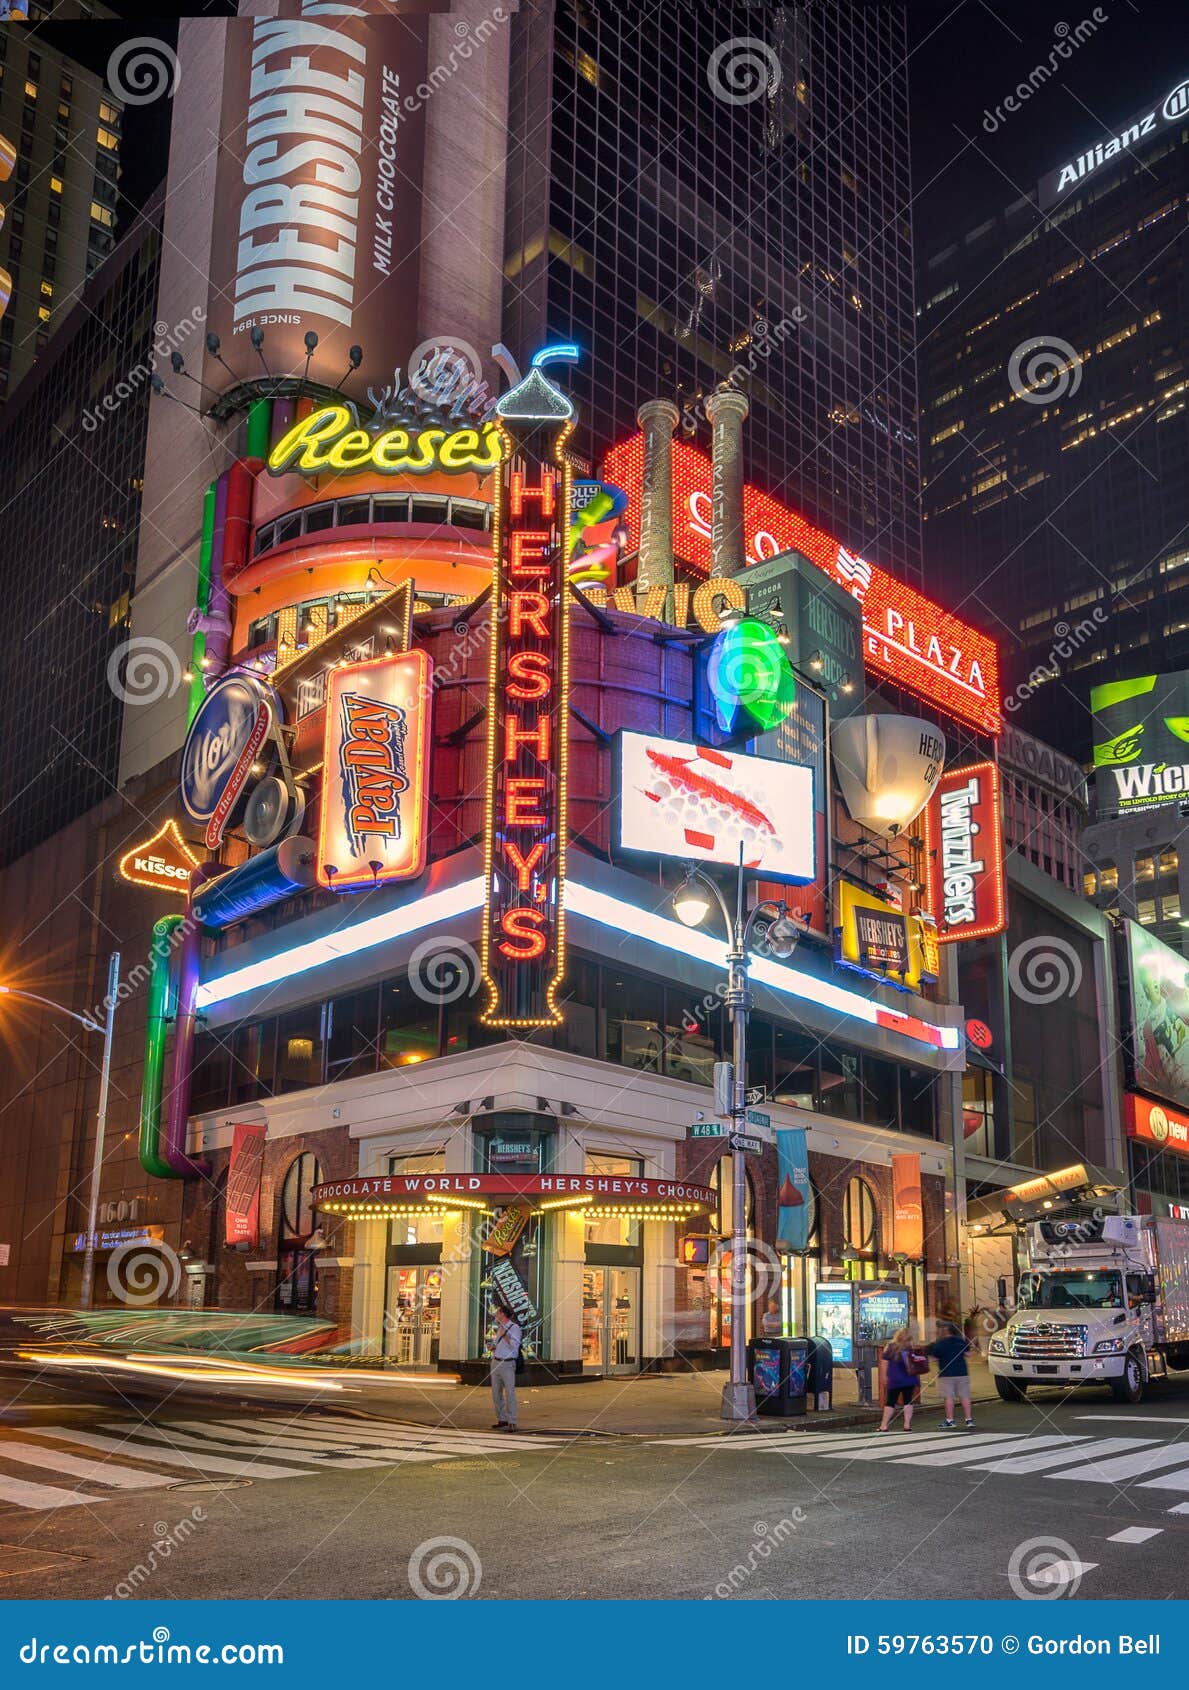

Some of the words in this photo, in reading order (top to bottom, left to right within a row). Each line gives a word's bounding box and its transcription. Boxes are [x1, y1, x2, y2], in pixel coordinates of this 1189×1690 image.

[377, 64, 400, 213] CHOCOLATE
[1057, 112, 1157, 193] Allianz
[372, 208, 394, 276] MILK
[233, 317, 258, 336] 1894
[260, 314, 301, 326] SINCE
[268, 404, 505, 472] Reese's
[885, 606, 986, 691] PLAZA
[499, 471, 556, 959] HERSHEY'S
[344, 692, 407, 838] PayDay
[207, 817, 222, 843] Get
[217, 791, 233, 815] the
[940, 777, 986, 926] Twizzlers
[859, 916, 904, 948] HERSHEY'S
[694, 1126, 701, 1136] W
[701, 1125, 711, 1136] 48
[100, 1200, 138, 1223] 1601
[318, 1179, 392, 1200] CHOCOLATE
[404, 1178, 481, 1191] WORLD
[540, 1178, 648, 1194] HERSHEY'S
